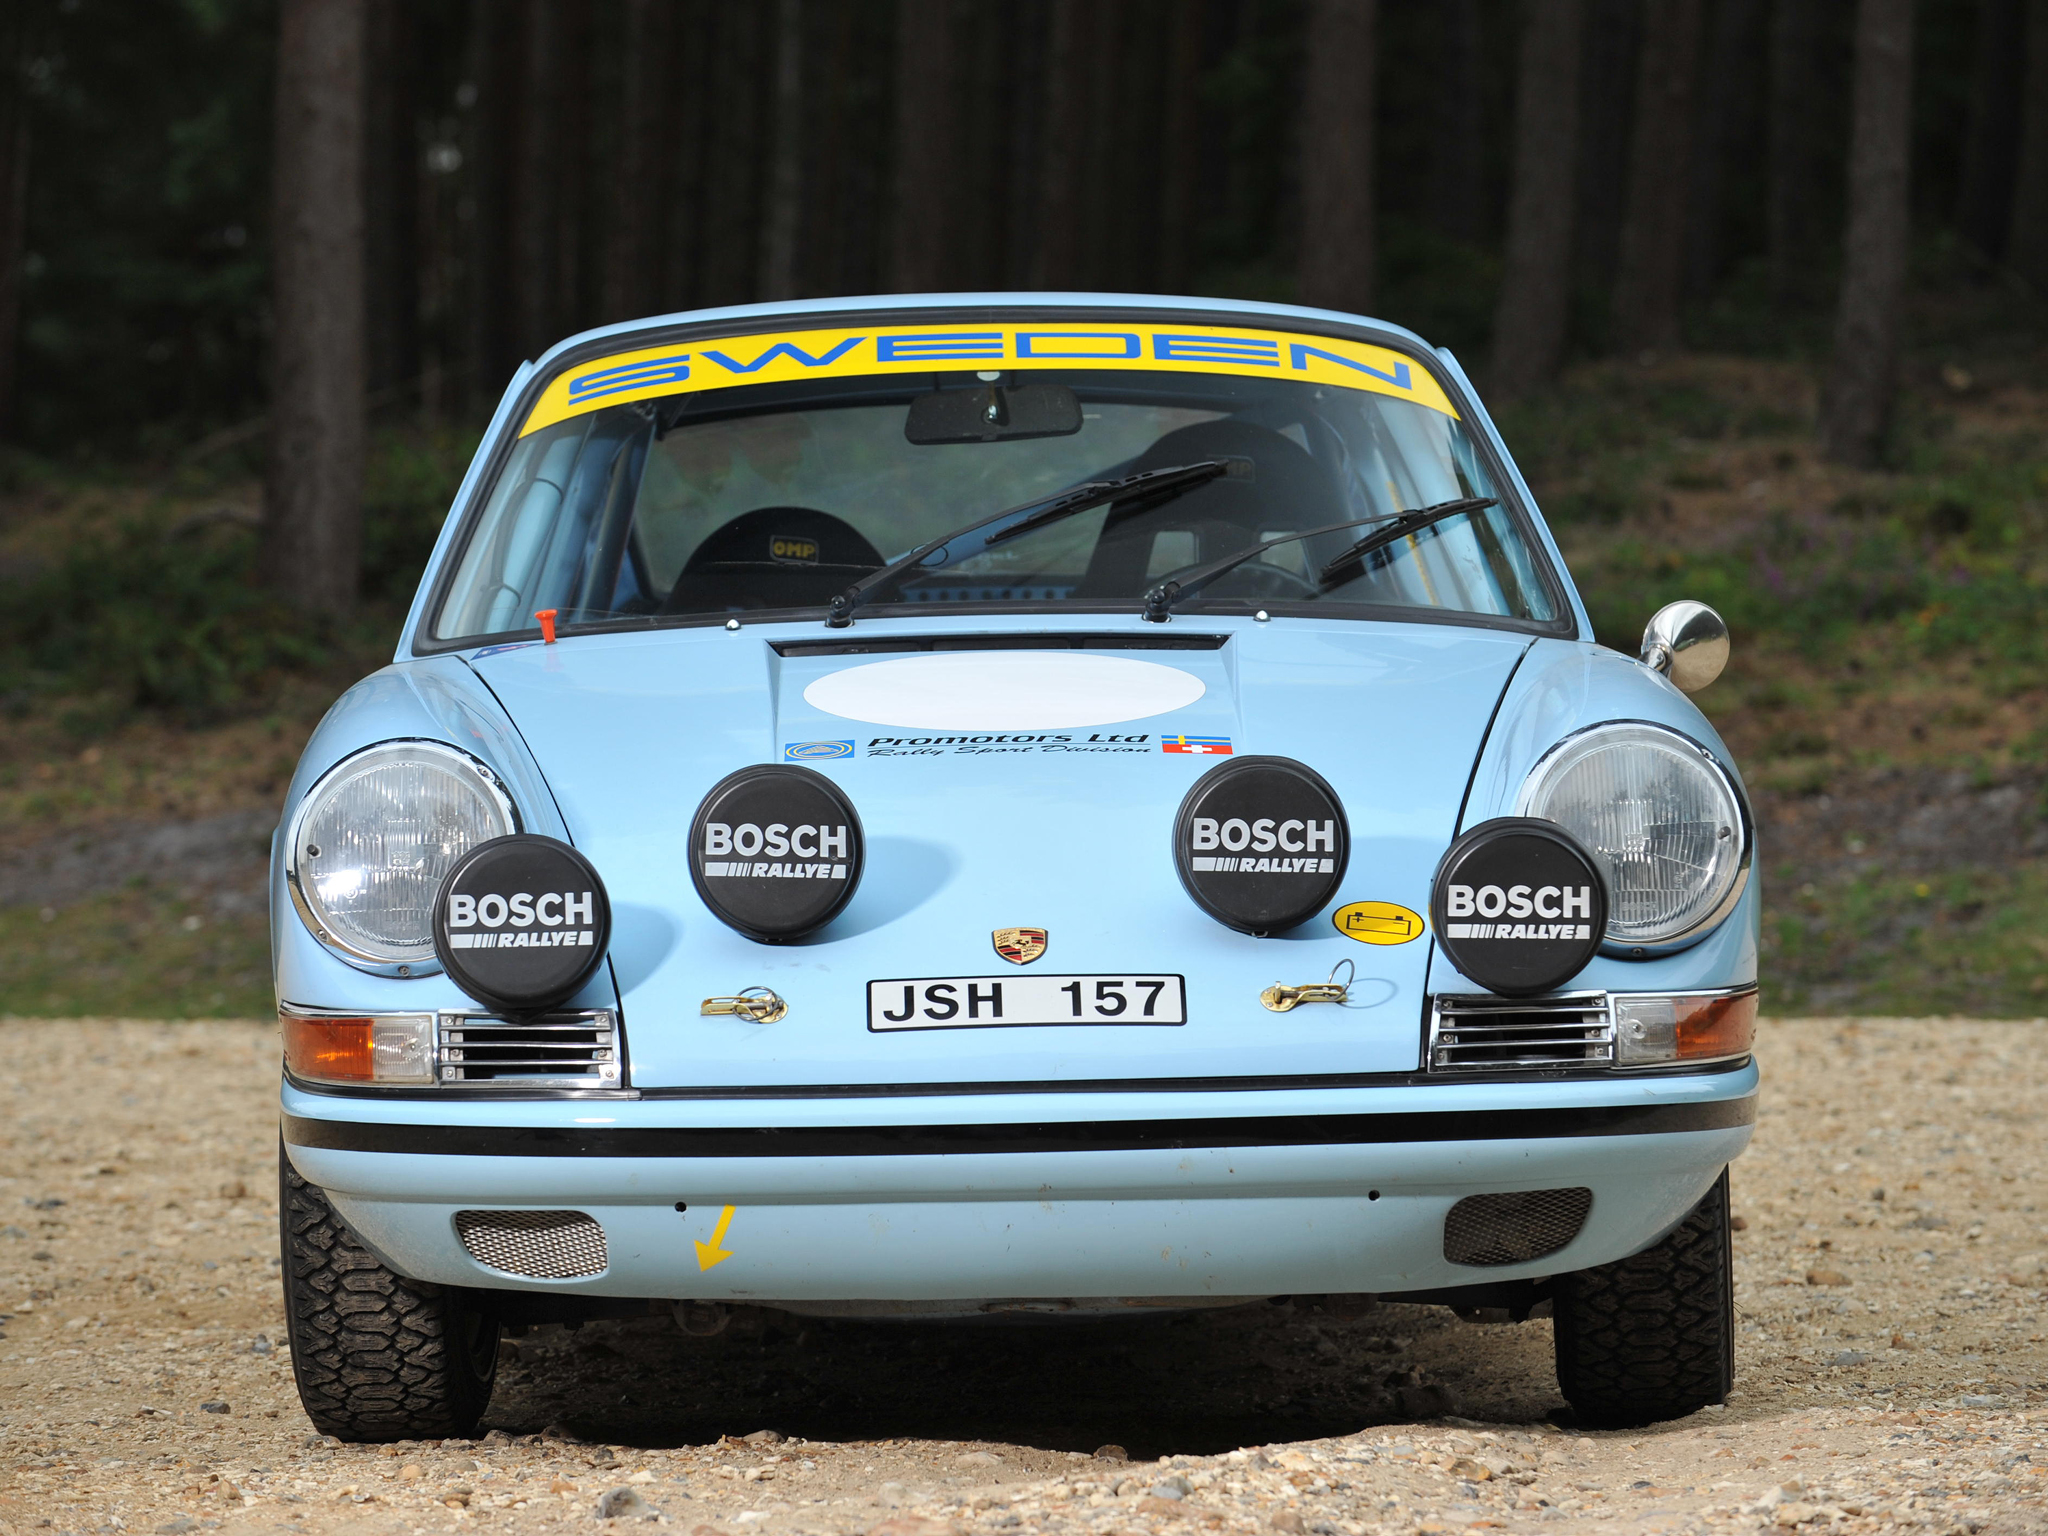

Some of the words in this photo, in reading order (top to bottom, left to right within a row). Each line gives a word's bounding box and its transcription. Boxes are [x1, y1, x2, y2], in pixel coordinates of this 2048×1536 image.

[568, 332, 1413, 405] SWEDEN
[773, 541, 816, 558] OMP
[1087, 734, 1150, 743] Ltd
[867, 748, 944, 757] Rally
[954, 746, 1034, 755] Sport
[1040, 745, 1151, 753] Division
[705, 822, 847, 858] BOSCH
[1193, 817, 1334, 852] BOSCH
[751, 862, 831, 879] RALLYE
[1238, 857, 1318, 873] RALLYE
[450, 891, 593, 928] BOSCH
[1447, 884, 1590, 919] BOSCH
[498, 930, 578, 948] RALLYE
[1494, 924, 1576, 940] RALLYE
[883, 982, 1003, 1022] JSH
[1060, 981, 1165, 1017] 157
